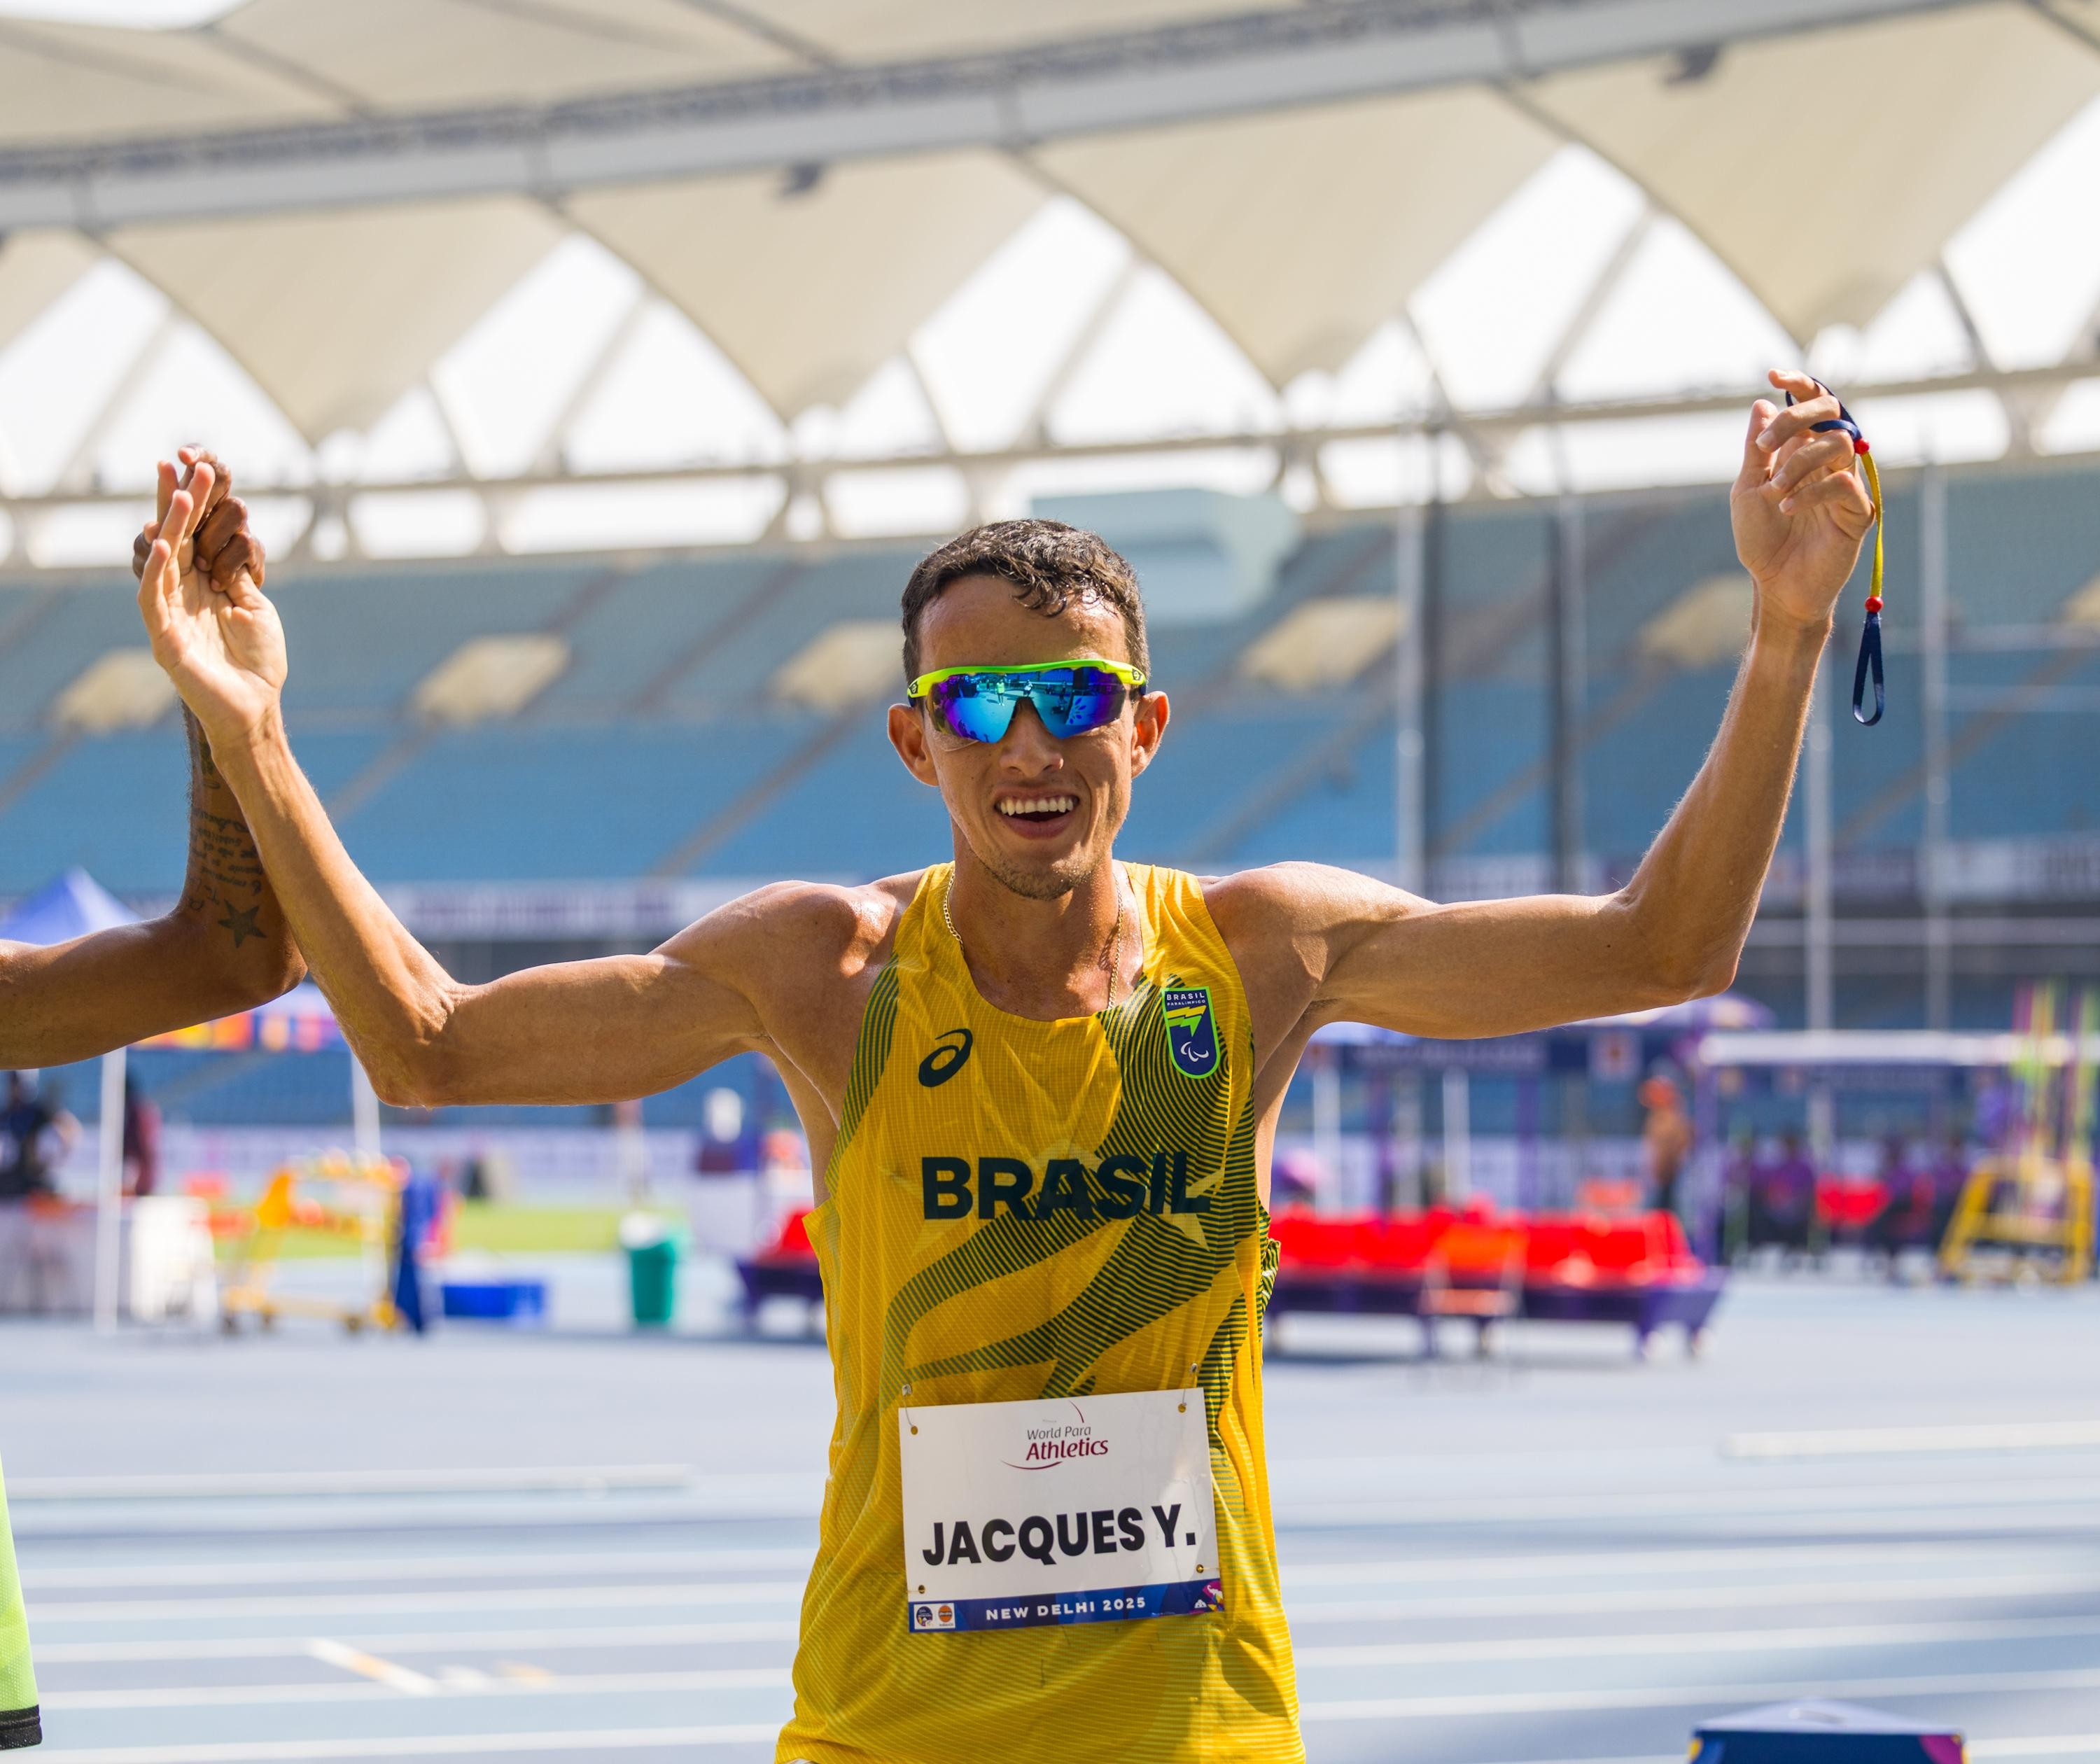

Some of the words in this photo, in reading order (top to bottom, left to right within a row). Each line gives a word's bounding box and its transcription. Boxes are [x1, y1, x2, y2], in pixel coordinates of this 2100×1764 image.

[922, 1152, 1210, 1221] BRASIL
[1027, 1427, 1061, 1440] World
[1065, 1426, 1091, 1437] Para
[1026, 1437, 1108, 1461] Athletics
[923, 1507, 1145, 1566] JACQUES
[1152, 1504, 1196, 1548] Y.
[986, 1606, 1028, 1620] NEW
[1037, 1602, 1095, 1616] DELHI
[1103, 1597, 1145, 1611] 2025
